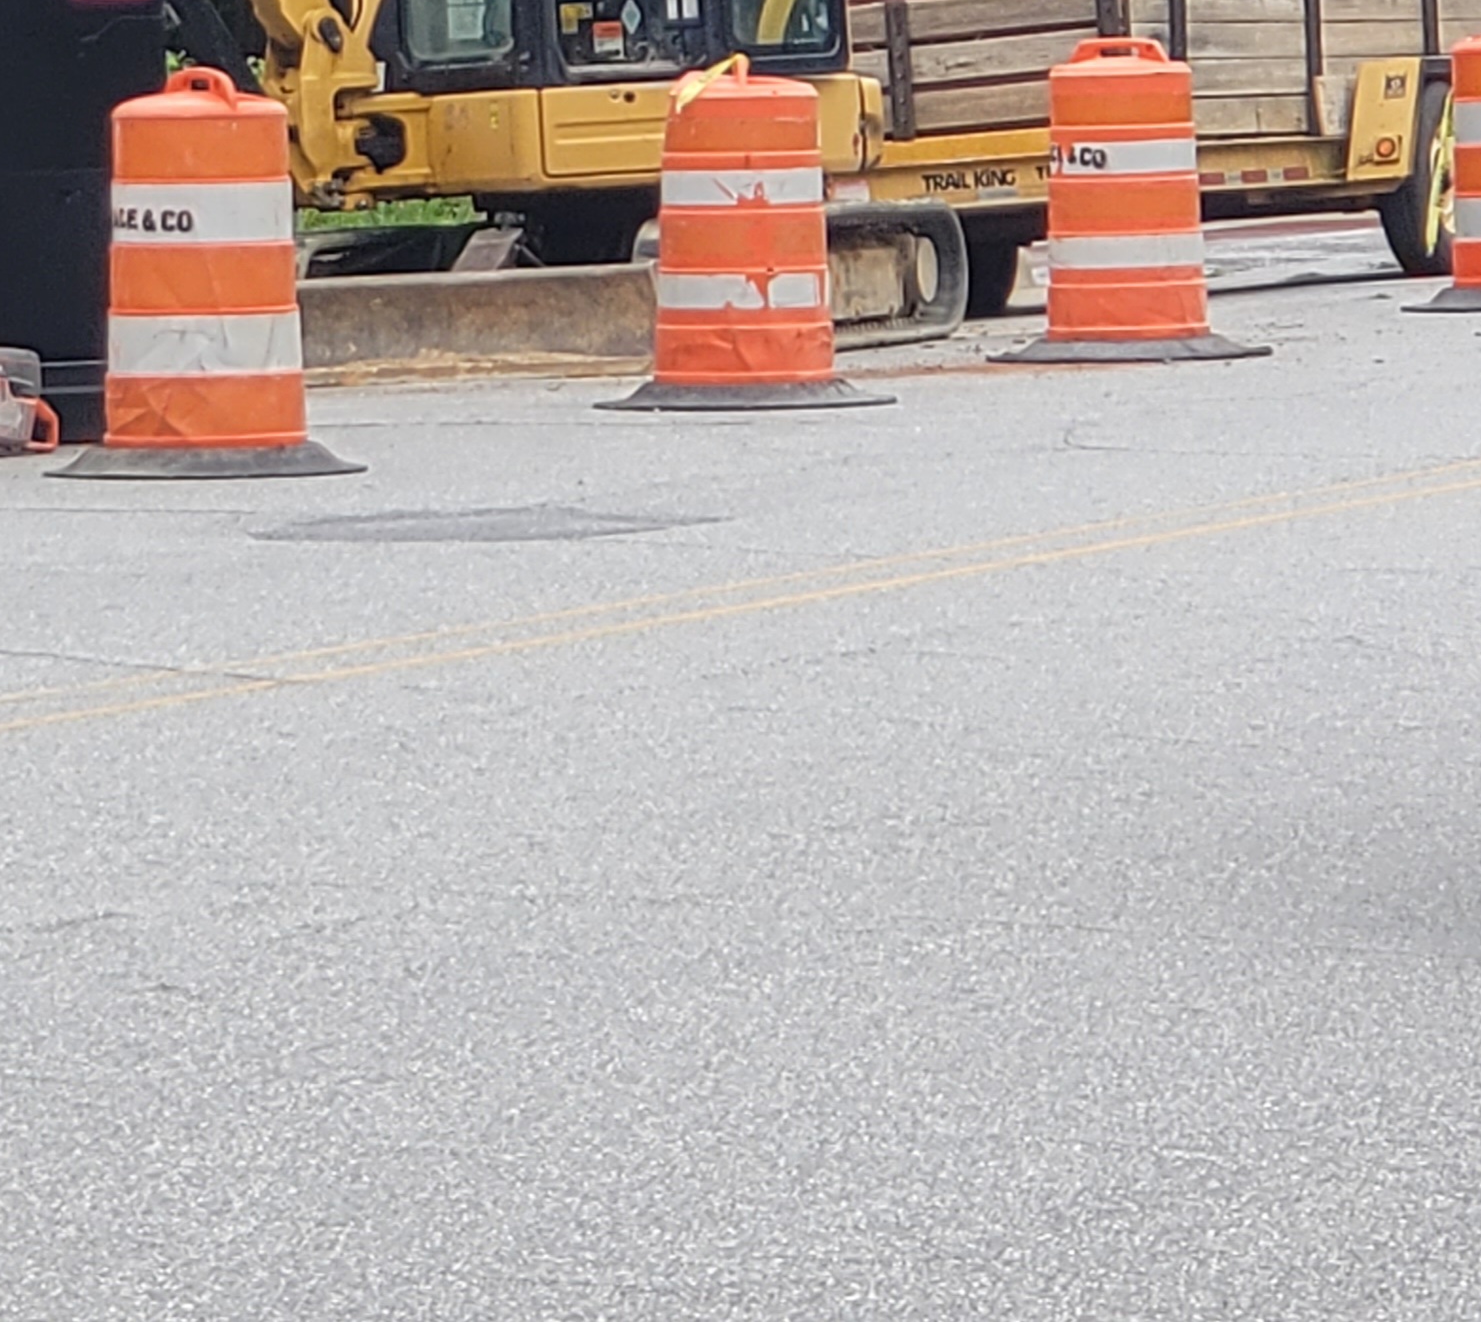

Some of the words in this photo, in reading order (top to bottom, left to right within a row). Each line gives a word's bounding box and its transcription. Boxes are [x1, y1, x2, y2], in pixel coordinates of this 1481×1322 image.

[922, 172, 971, 193] TRAIL
[974, 168, 1016, 189] KING
[161, 210, 194, 233] CO
